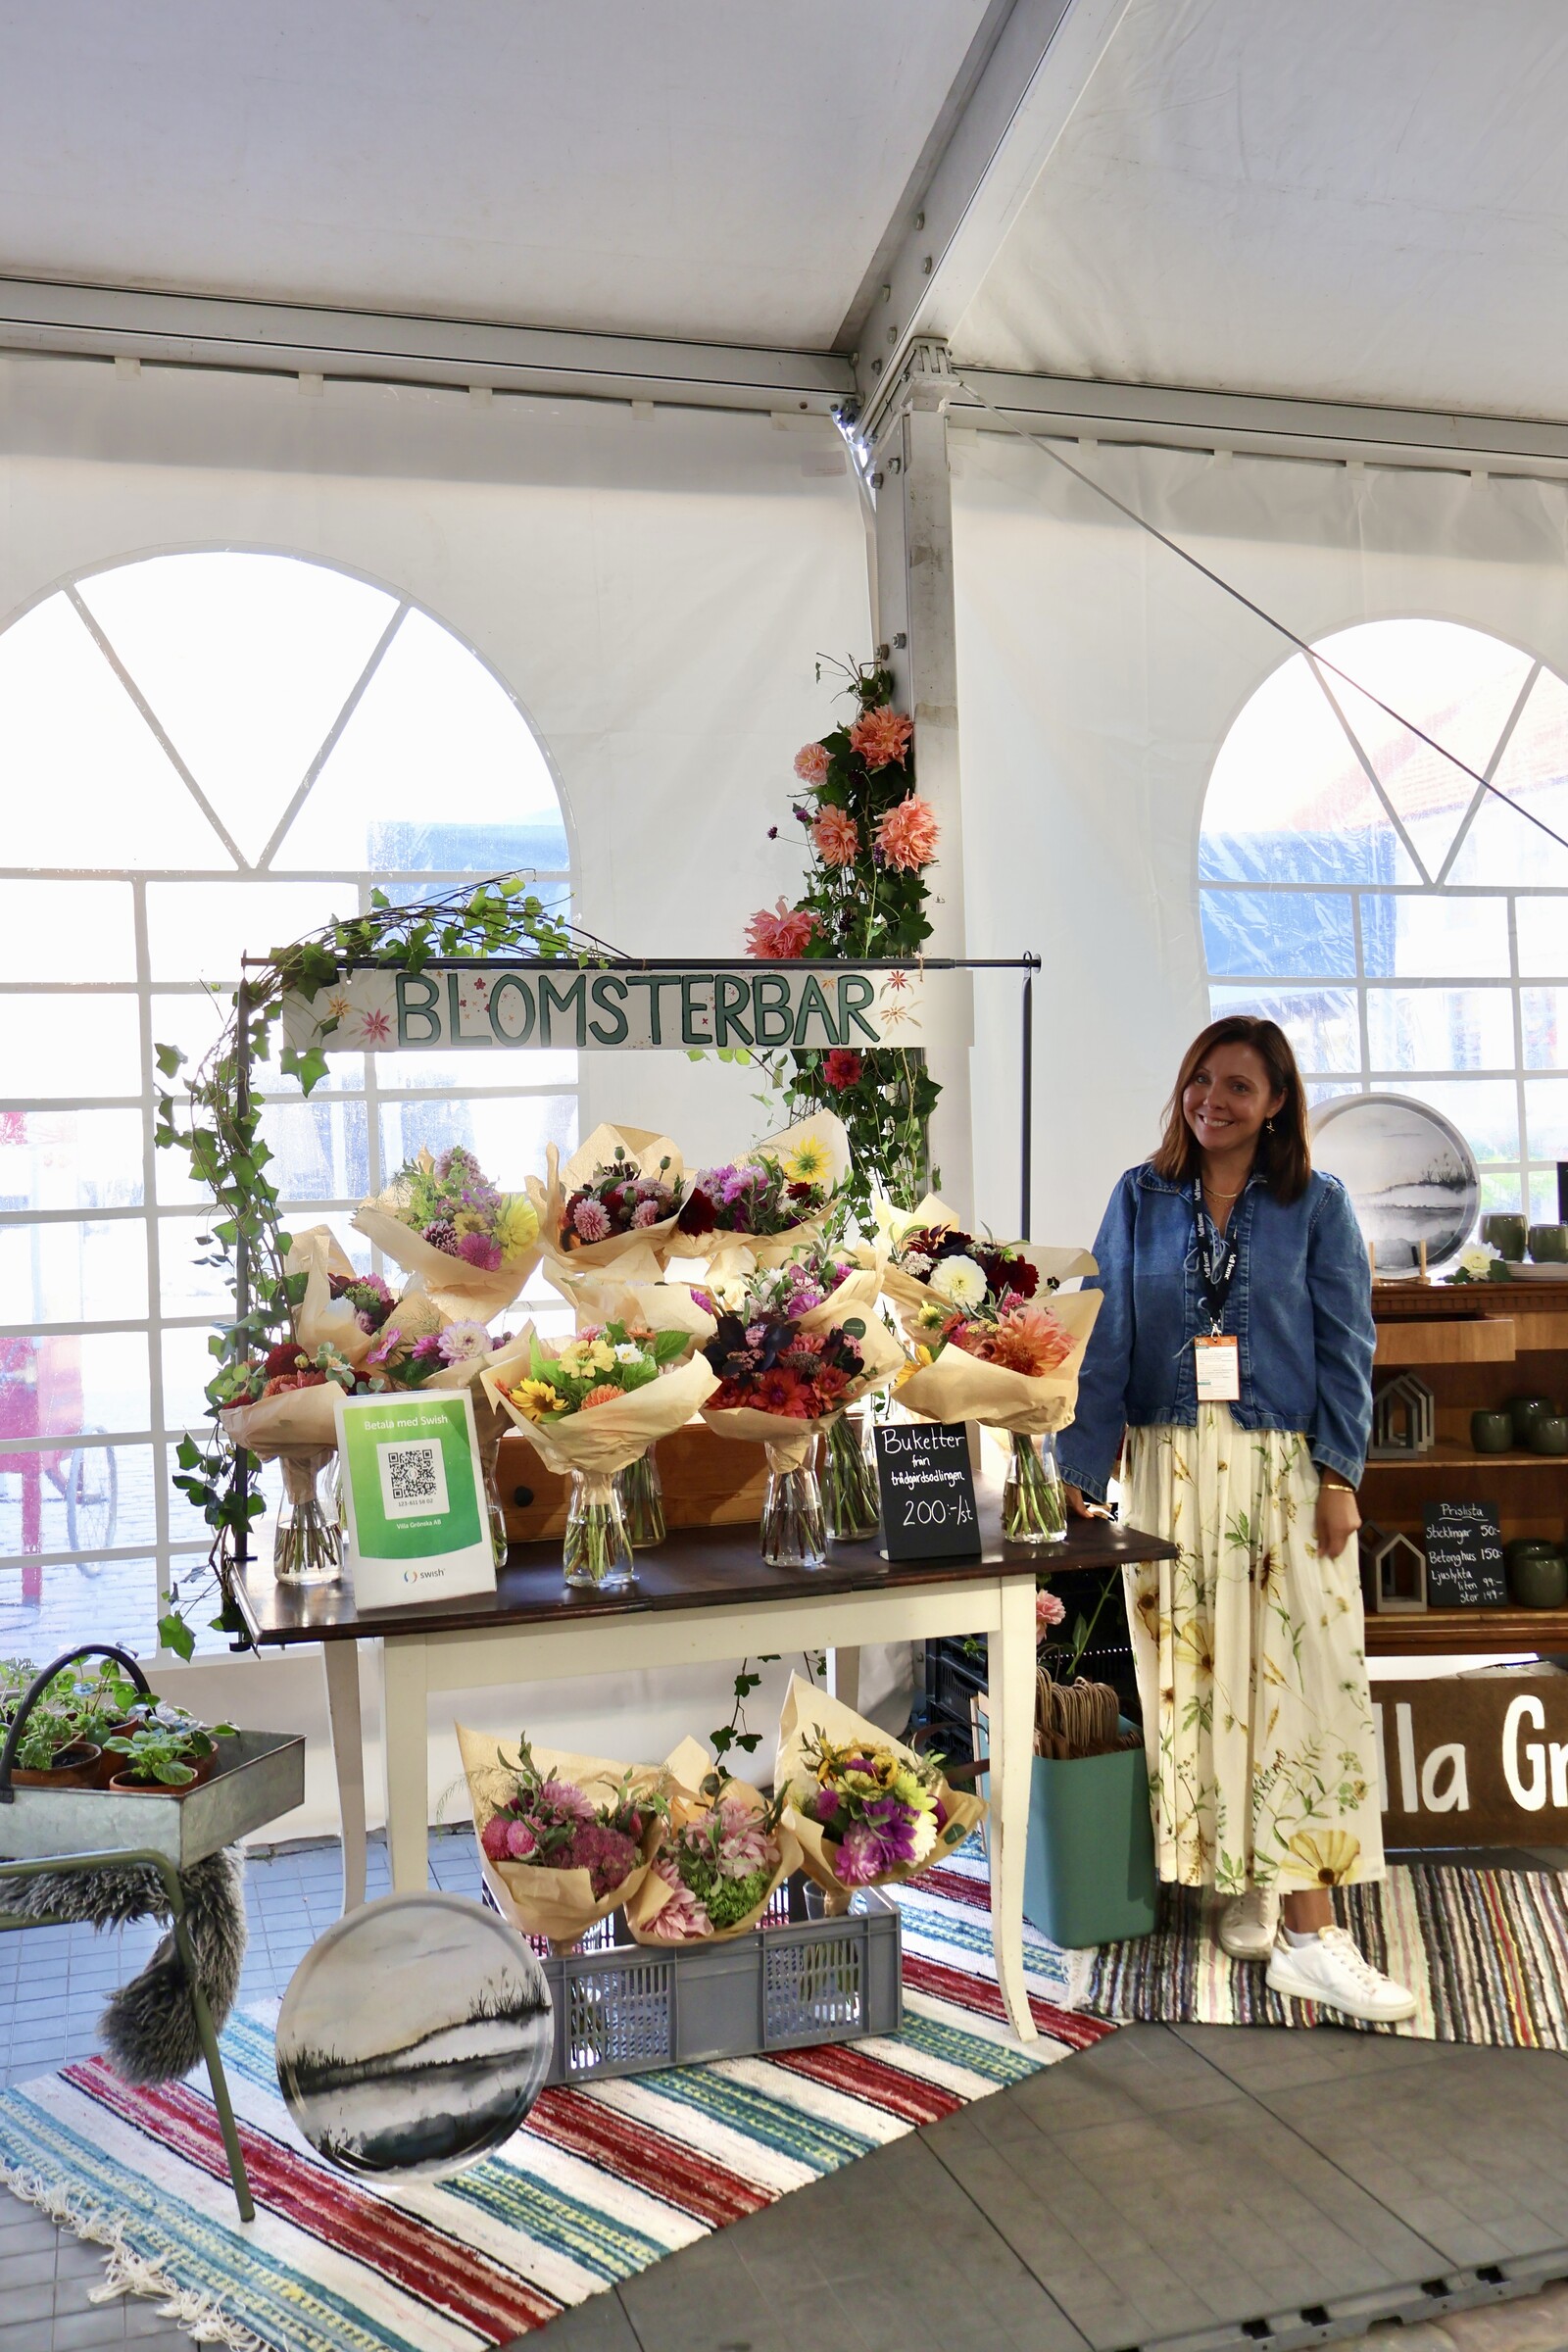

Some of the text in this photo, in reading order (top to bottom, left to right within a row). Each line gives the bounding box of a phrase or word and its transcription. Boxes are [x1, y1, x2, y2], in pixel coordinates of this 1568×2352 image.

[396, 973, 880, 1047] BLOMSTERBAR
[365, 1414, 449, 1431] Betala med Swish
[881, 1427, 966, 1454] Buketter
[1440, 1503, 1485, 1517] Prislista
[1426, 1524, 1473, 1545] Sticklingar
[1428, 1549, 1477, 1567] Betonghus
[419, 1567, 446, 1579] swish
[1431, 1568, 1473, 1586] Ljuslykta
